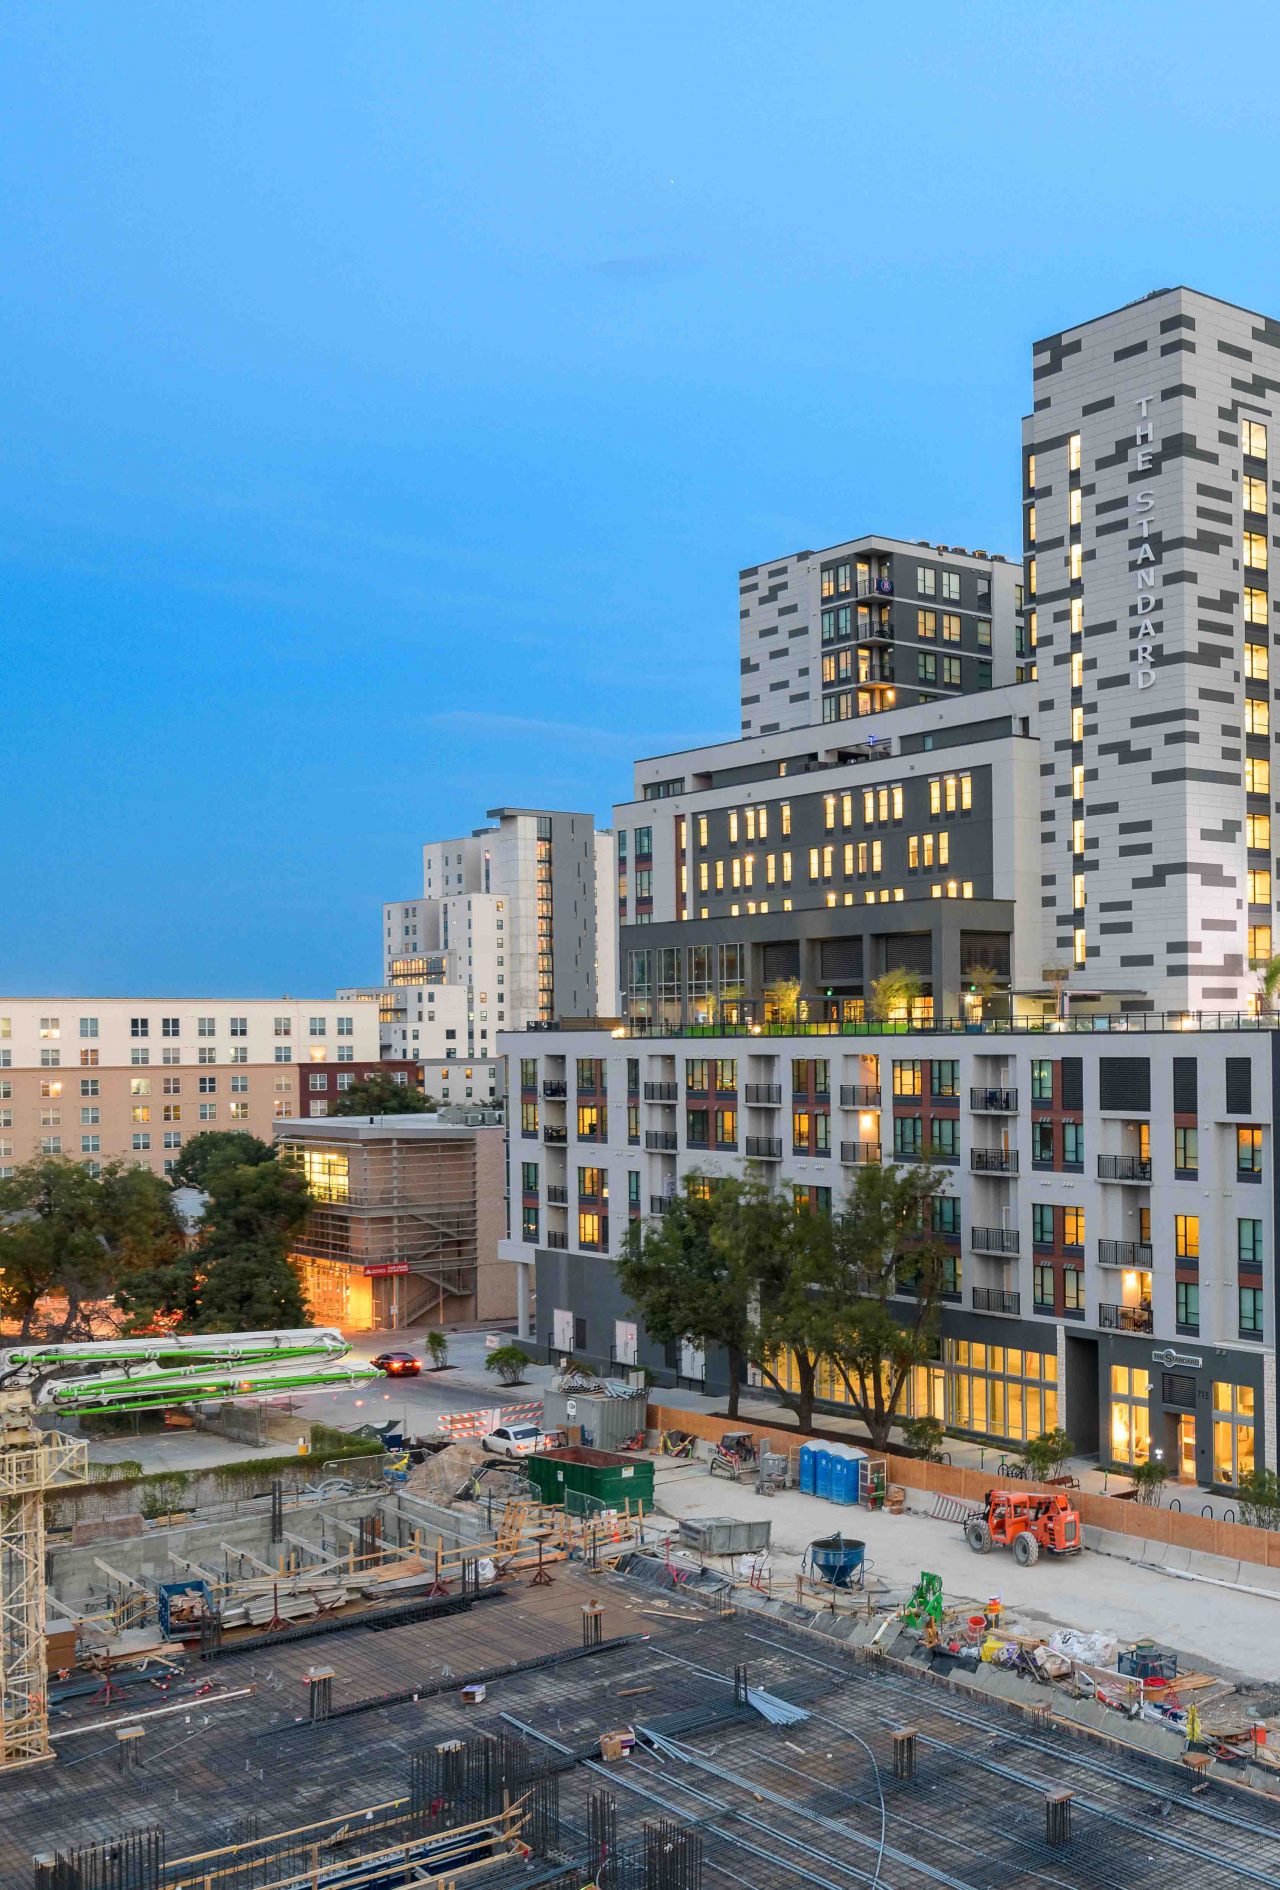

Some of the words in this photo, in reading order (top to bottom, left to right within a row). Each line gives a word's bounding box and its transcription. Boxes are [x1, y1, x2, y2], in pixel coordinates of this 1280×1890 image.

[1135, 396, 1154, 472] THE
[1136, 490, 1157, 690] STANDARD
[1197, 1390, 1209, 1400] 715
